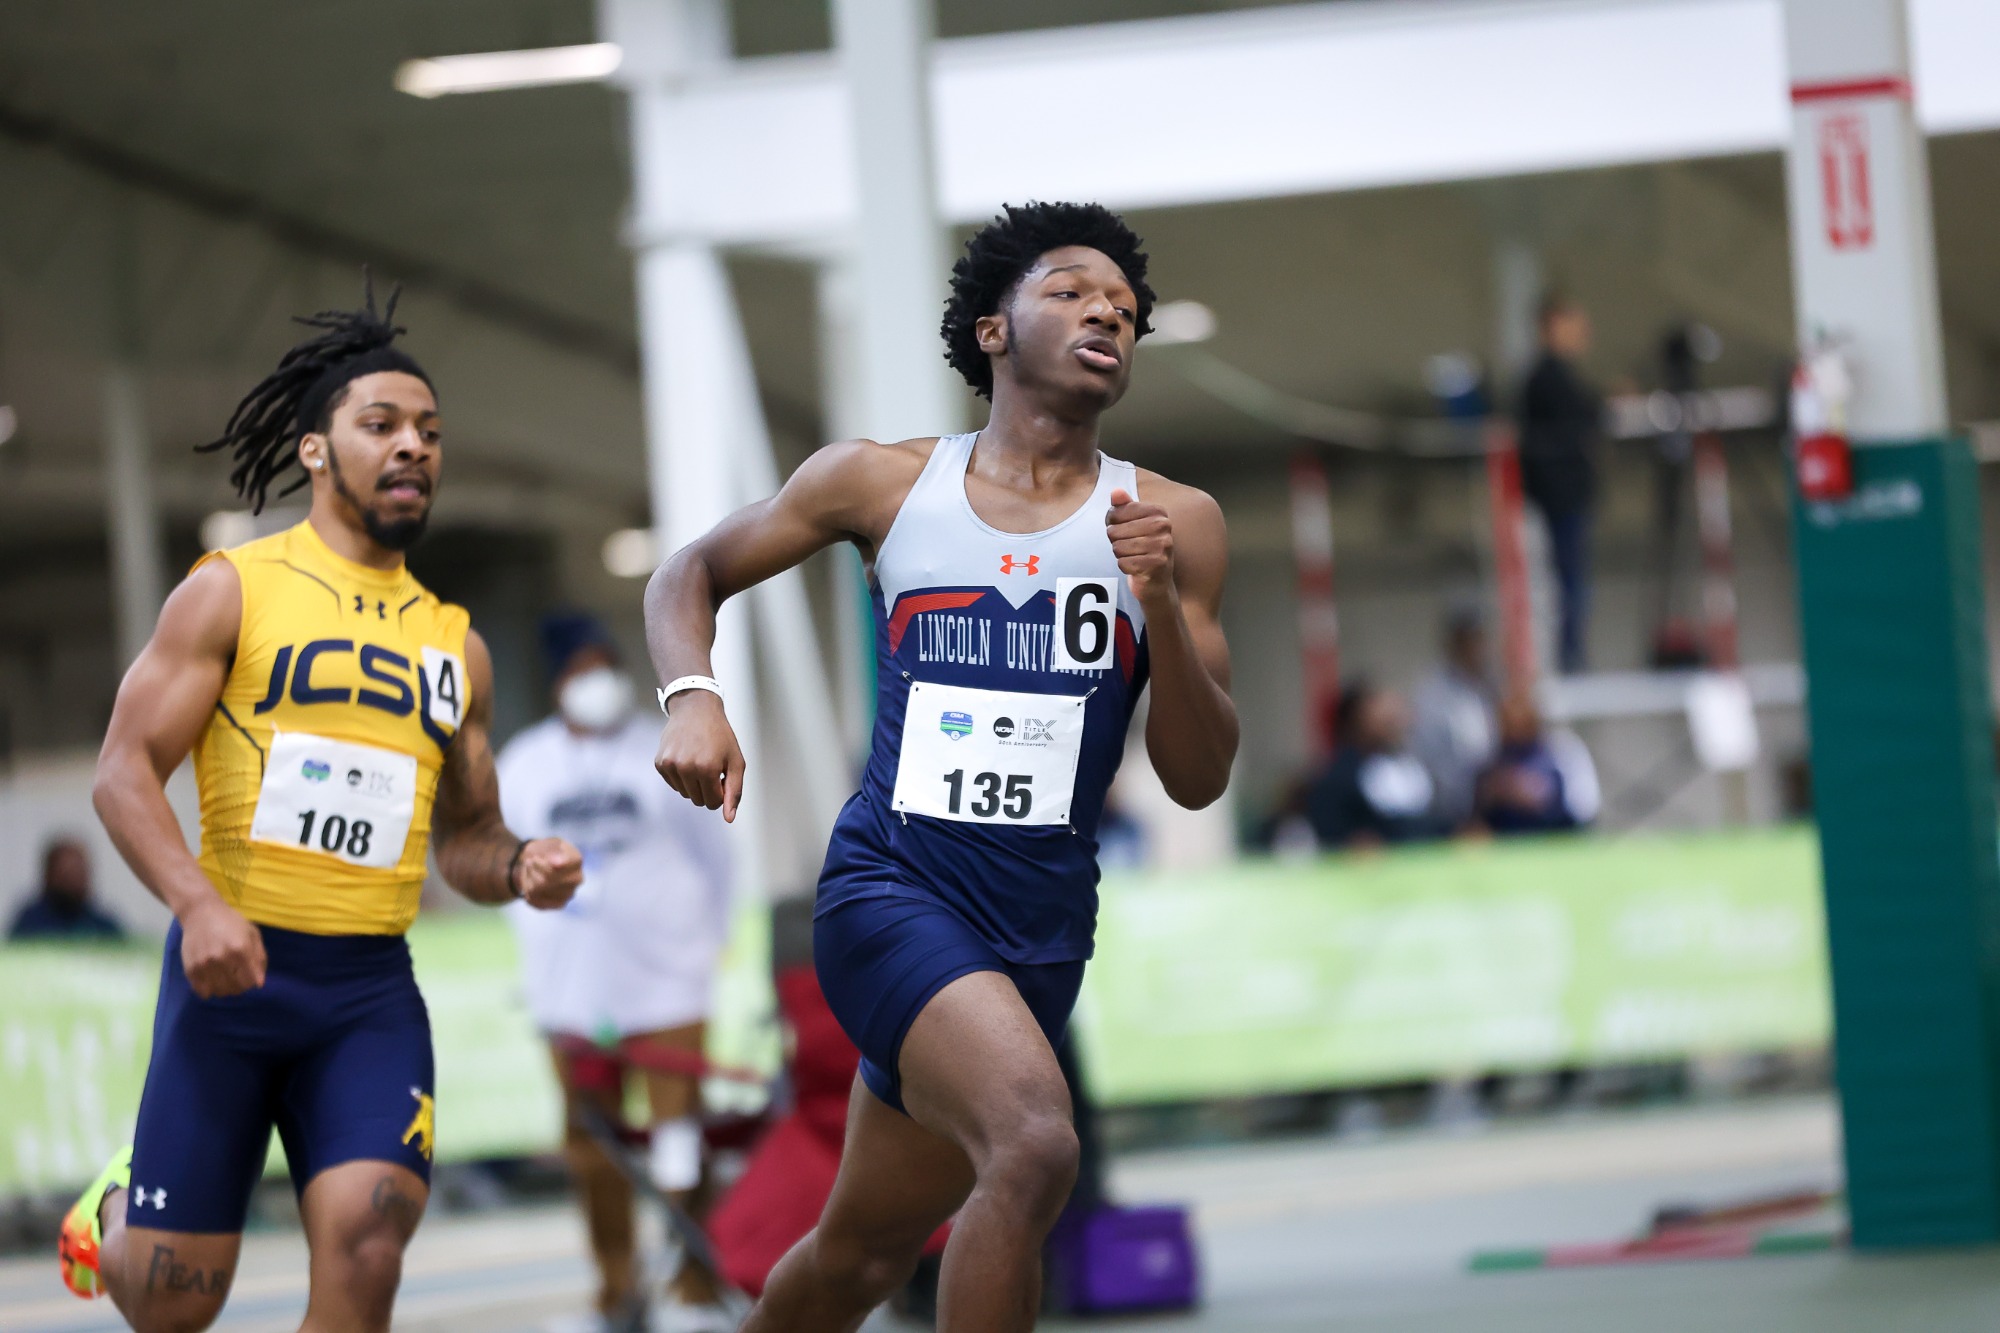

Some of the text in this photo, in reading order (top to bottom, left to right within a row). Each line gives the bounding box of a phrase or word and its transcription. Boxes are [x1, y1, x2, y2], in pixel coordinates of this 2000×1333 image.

[917, 613, 991, 666] LINCOLN
[1064, 583, 1109, 664] 6
[438, 658, 458, 720] 4
[943, 768, 1033, 820] 135
[298, 809, 373, 857] 108
